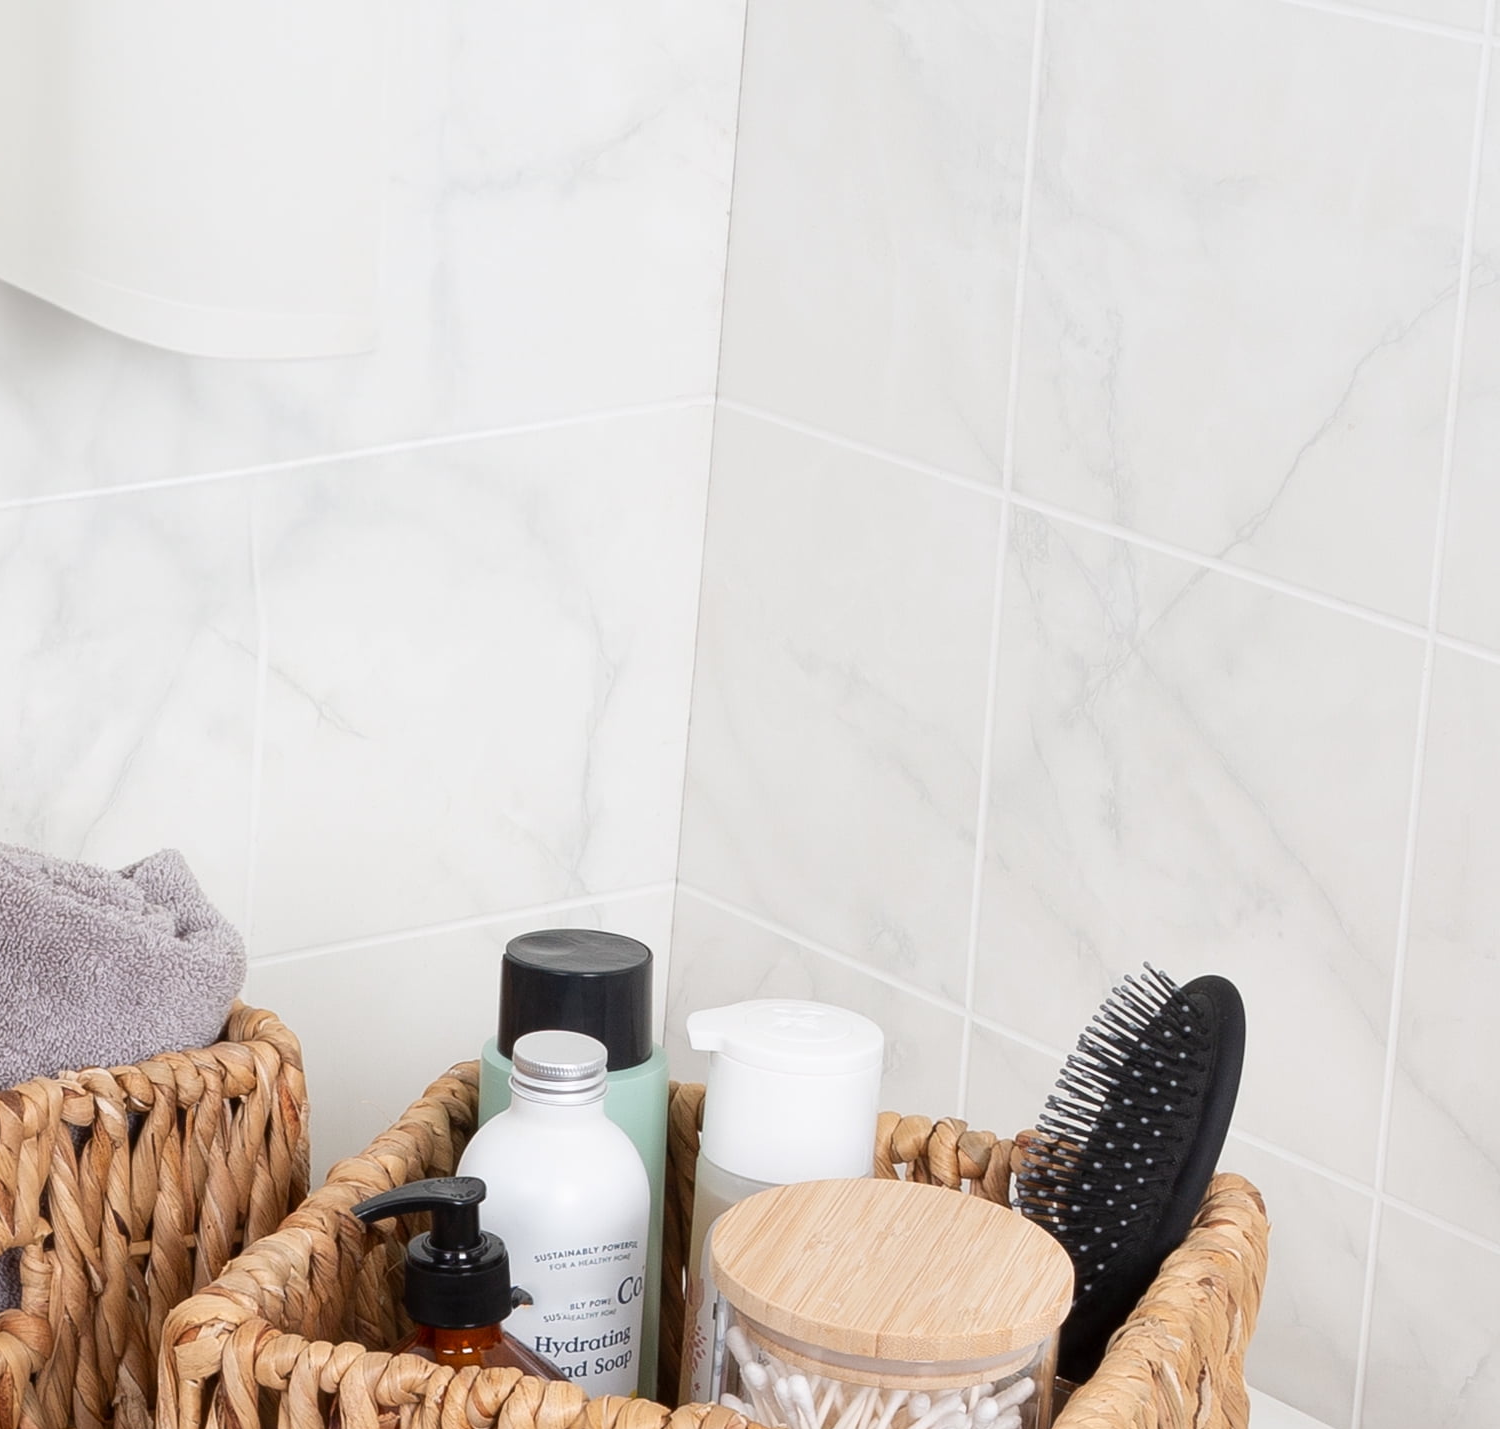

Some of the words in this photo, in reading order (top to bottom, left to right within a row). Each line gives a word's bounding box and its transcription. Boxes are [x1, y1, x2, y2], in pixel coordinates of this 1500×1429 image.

[534, 1246, 599, 1263] SUSTAINABLY
[548, 1262, 567, 1271] FOR
[578, 1256, 611, 1267] HEALTHY
[535, 1326, 631, 1357] Hydrating
[561, 1361, 587, 1378] nd
[594, 1350, 632, 1374] Soap
